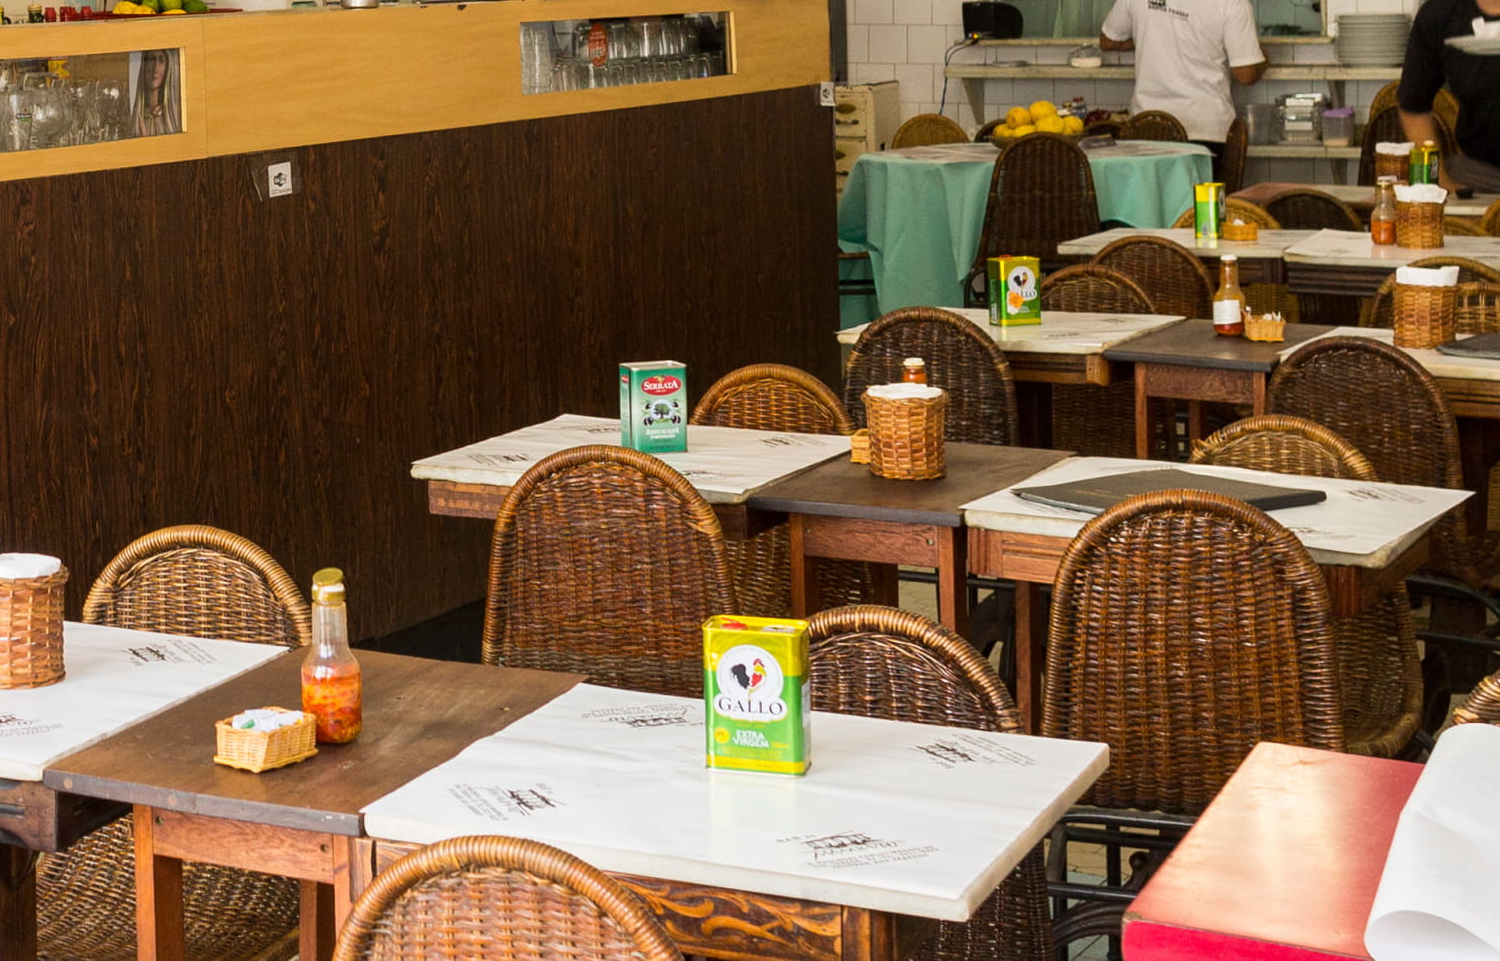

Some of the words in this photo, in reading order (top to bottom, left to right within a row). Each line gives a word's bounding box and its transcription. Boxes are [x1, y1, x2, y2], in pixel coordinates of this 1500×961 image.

[643, 380, 679, 391] SERRATA
[718, 696, 783, 716] GALLO
[736, 729, 765, 739] EXTRA
[732, 737, 770, 749] VIRGEM
